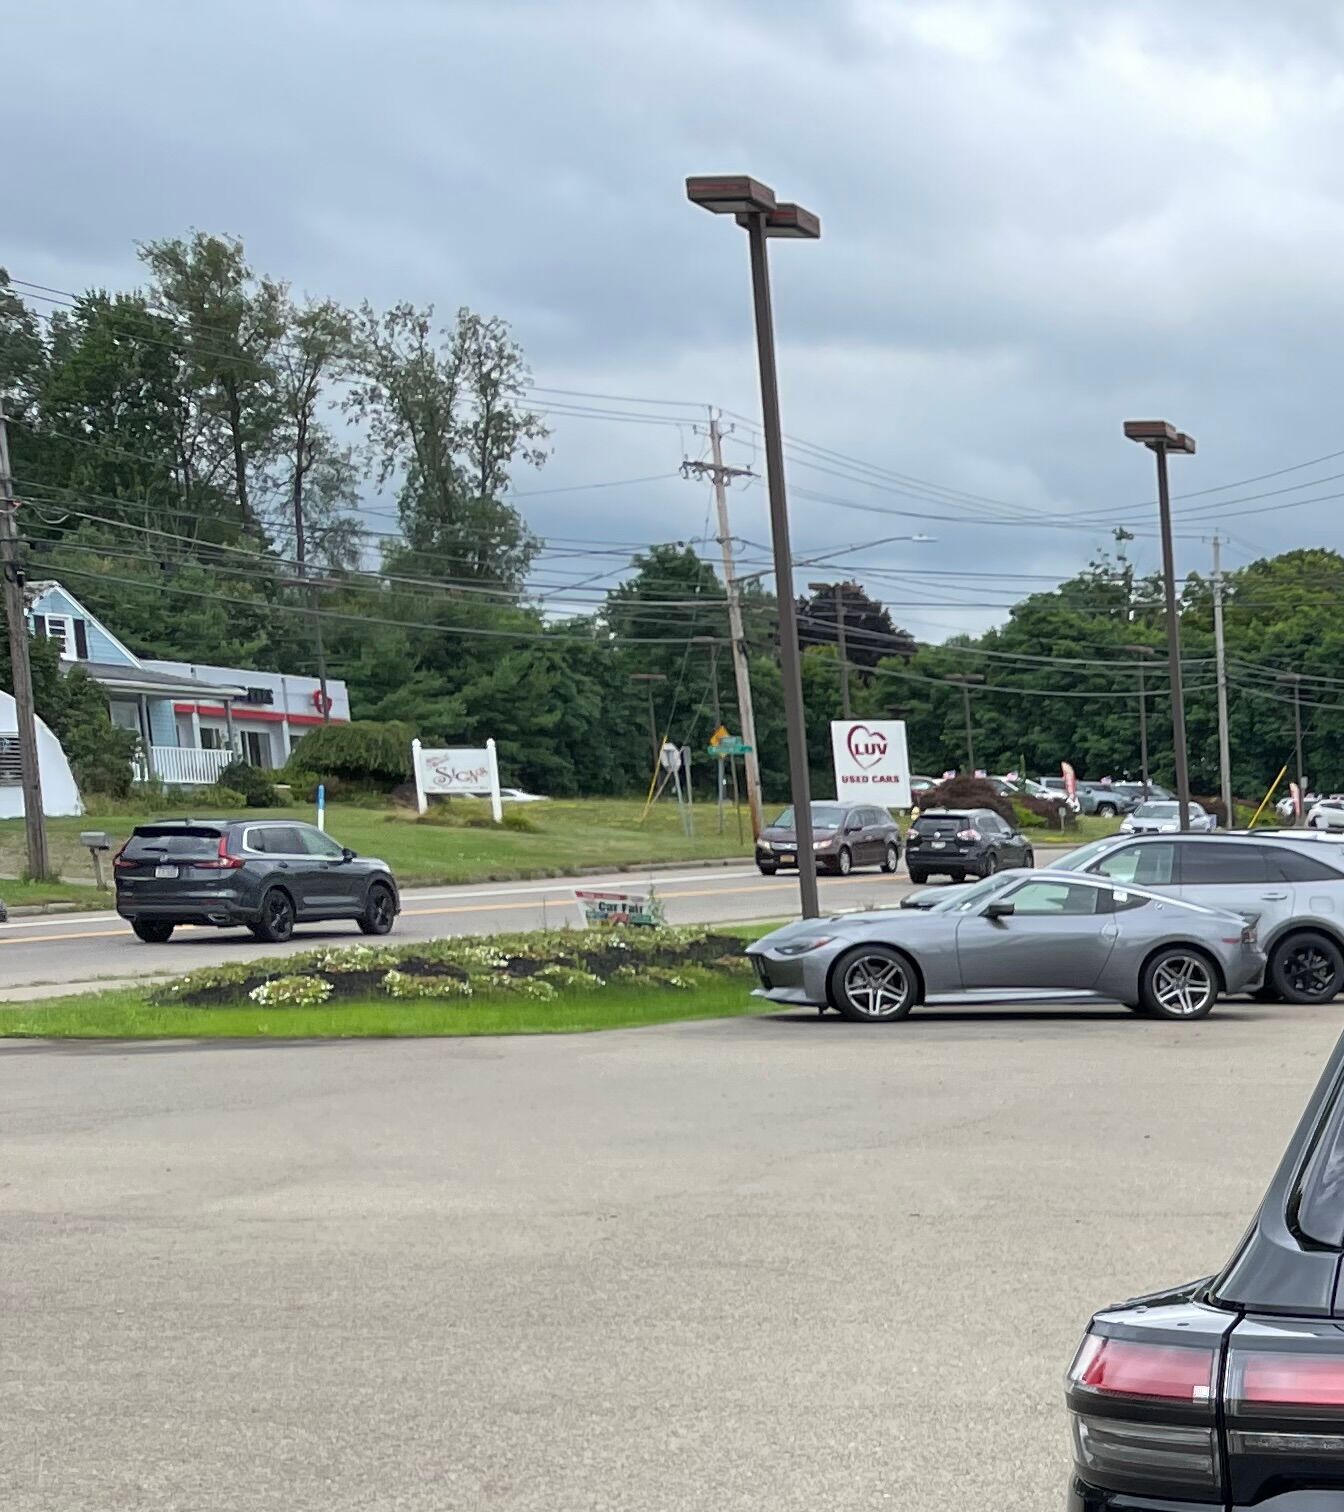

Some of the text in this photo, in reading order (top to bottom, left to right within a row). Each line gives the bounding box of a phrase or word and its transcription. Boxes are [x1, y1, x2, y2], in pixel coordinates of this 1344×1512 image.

[855, 743, 887, 755] LUV
[841, 775, 900, 784] USED CARS
